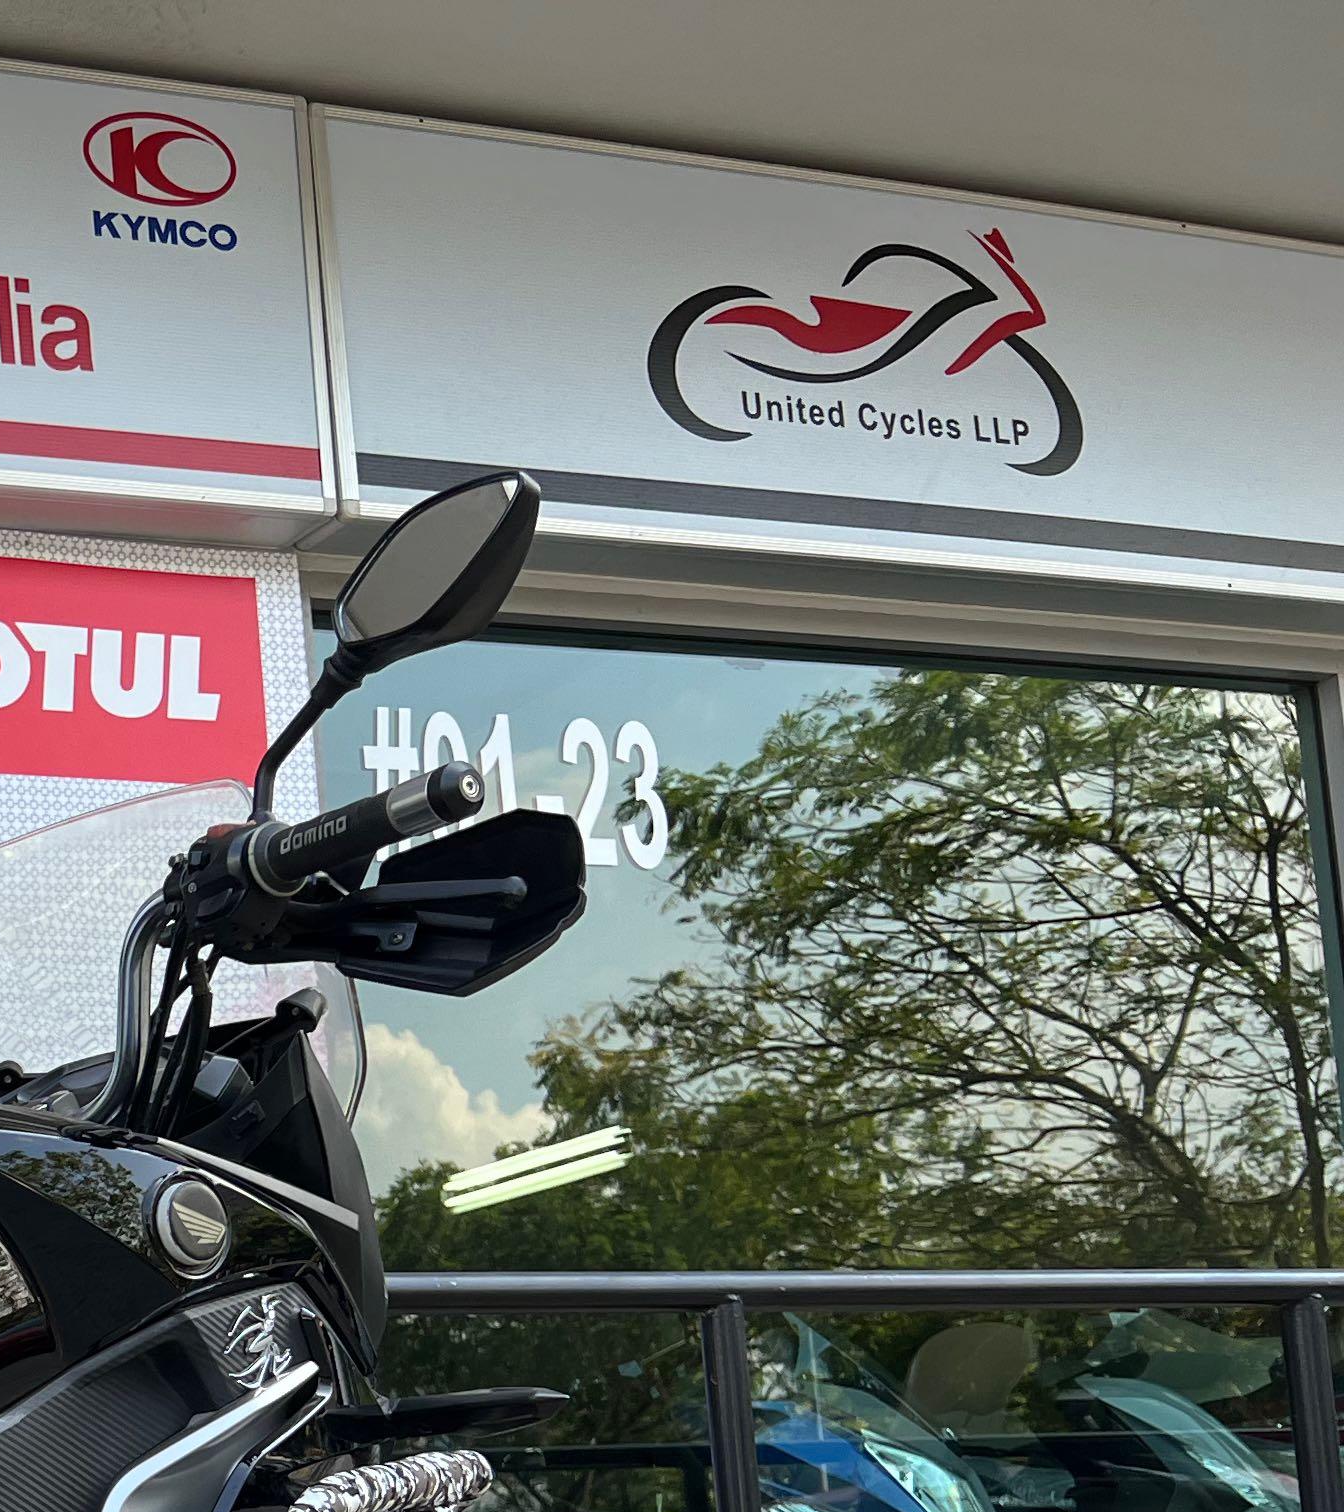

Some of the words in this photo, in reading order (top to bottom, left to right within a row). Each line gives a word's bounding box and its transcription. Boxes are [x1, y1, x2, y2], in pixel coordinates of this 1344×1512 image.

[92, 210, 238, 252] KYMCO
[741, 390, 845, 428] United
[857, 403, 961, 440] Cycles
[973, 414, 1030, 446] LLP
[279, 814, 348, 855] domino
